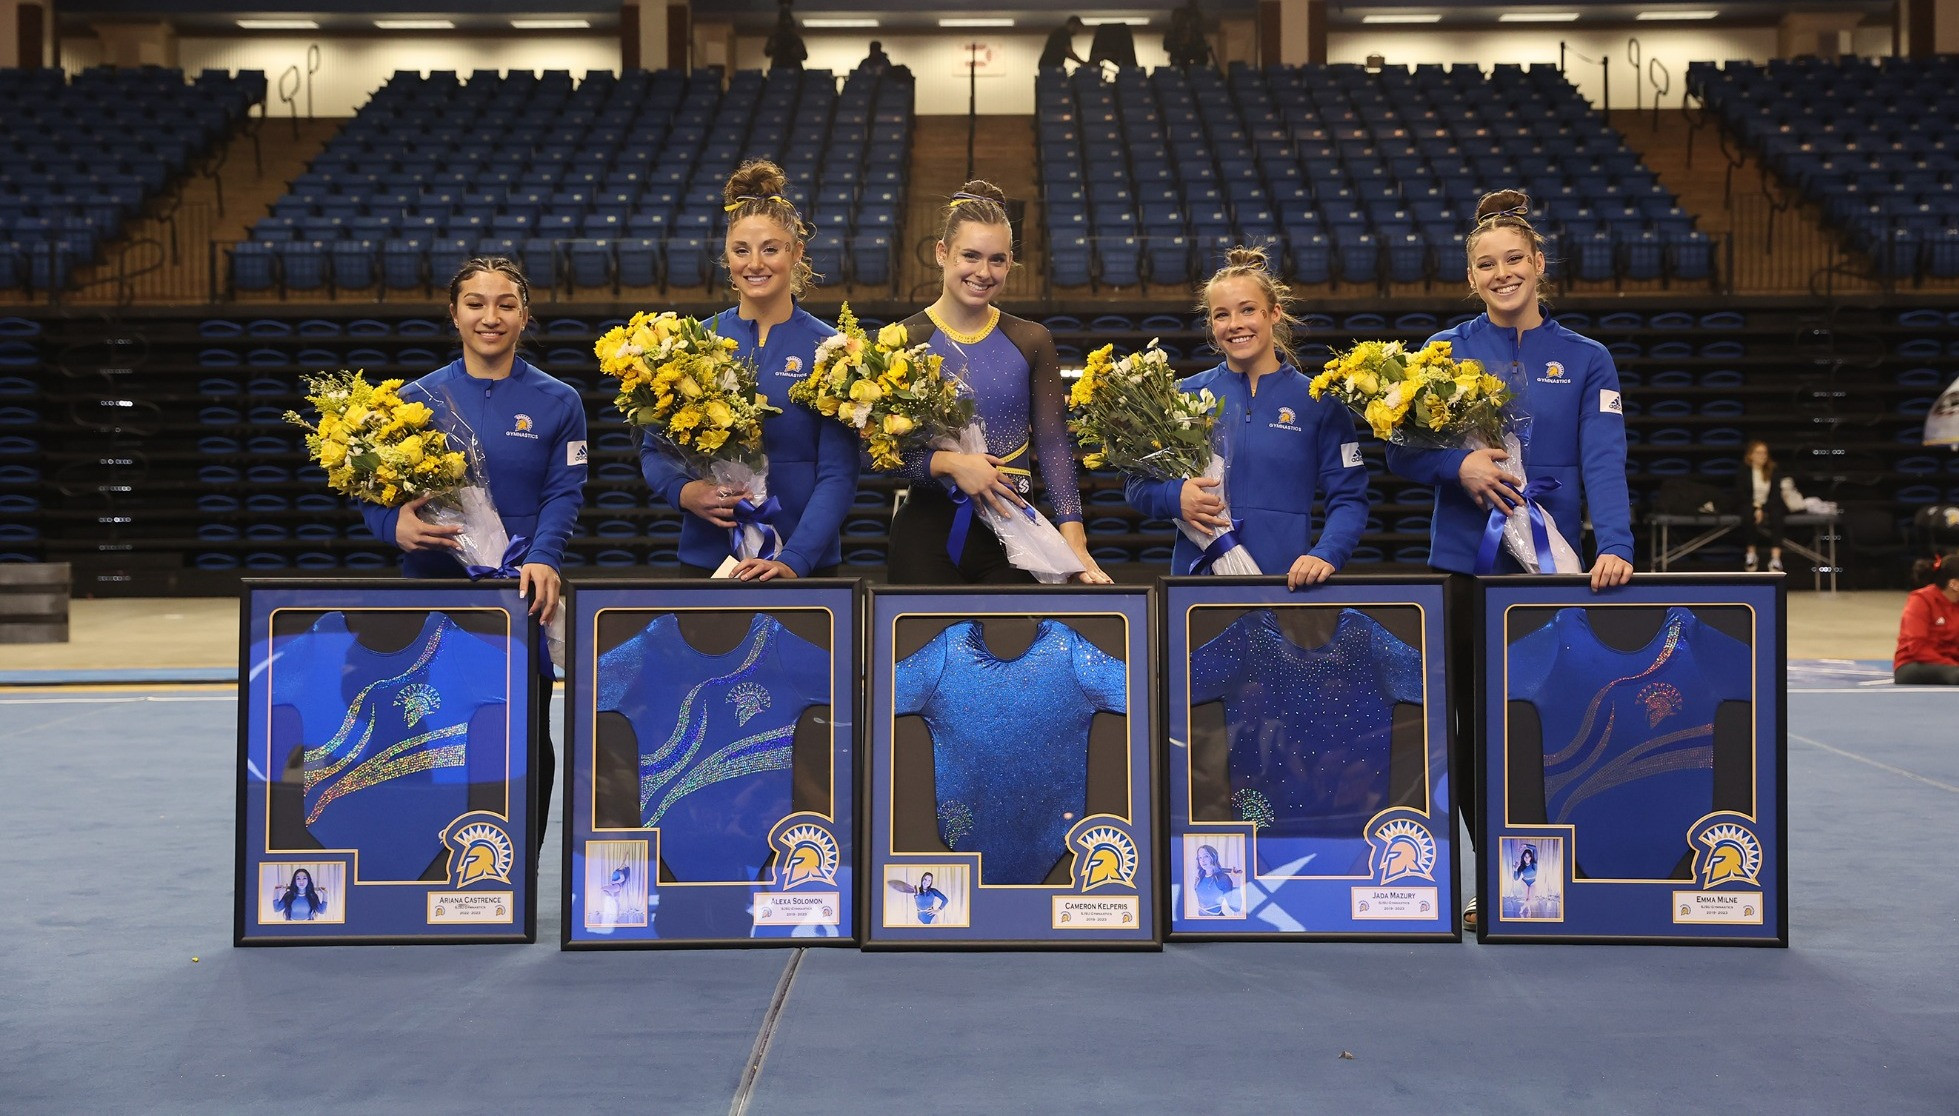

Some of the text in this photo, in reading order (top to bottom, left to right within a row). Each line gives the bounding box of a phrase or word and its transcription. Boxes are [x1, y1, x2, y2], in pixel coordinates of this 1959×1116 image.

[1268, 423, 1302, 432] GYMNASTICS
[505, 431, 539, 440] GYMNASTICS
[439, 896, 501, 904] ARIANA CASTRENCE
[771, 897, 823, 905] ALEXA SOLOMON
[1696, 895, 1715, 903] EMMA
[1064, 902, 1128, 910] CAMERON KELPERIS
